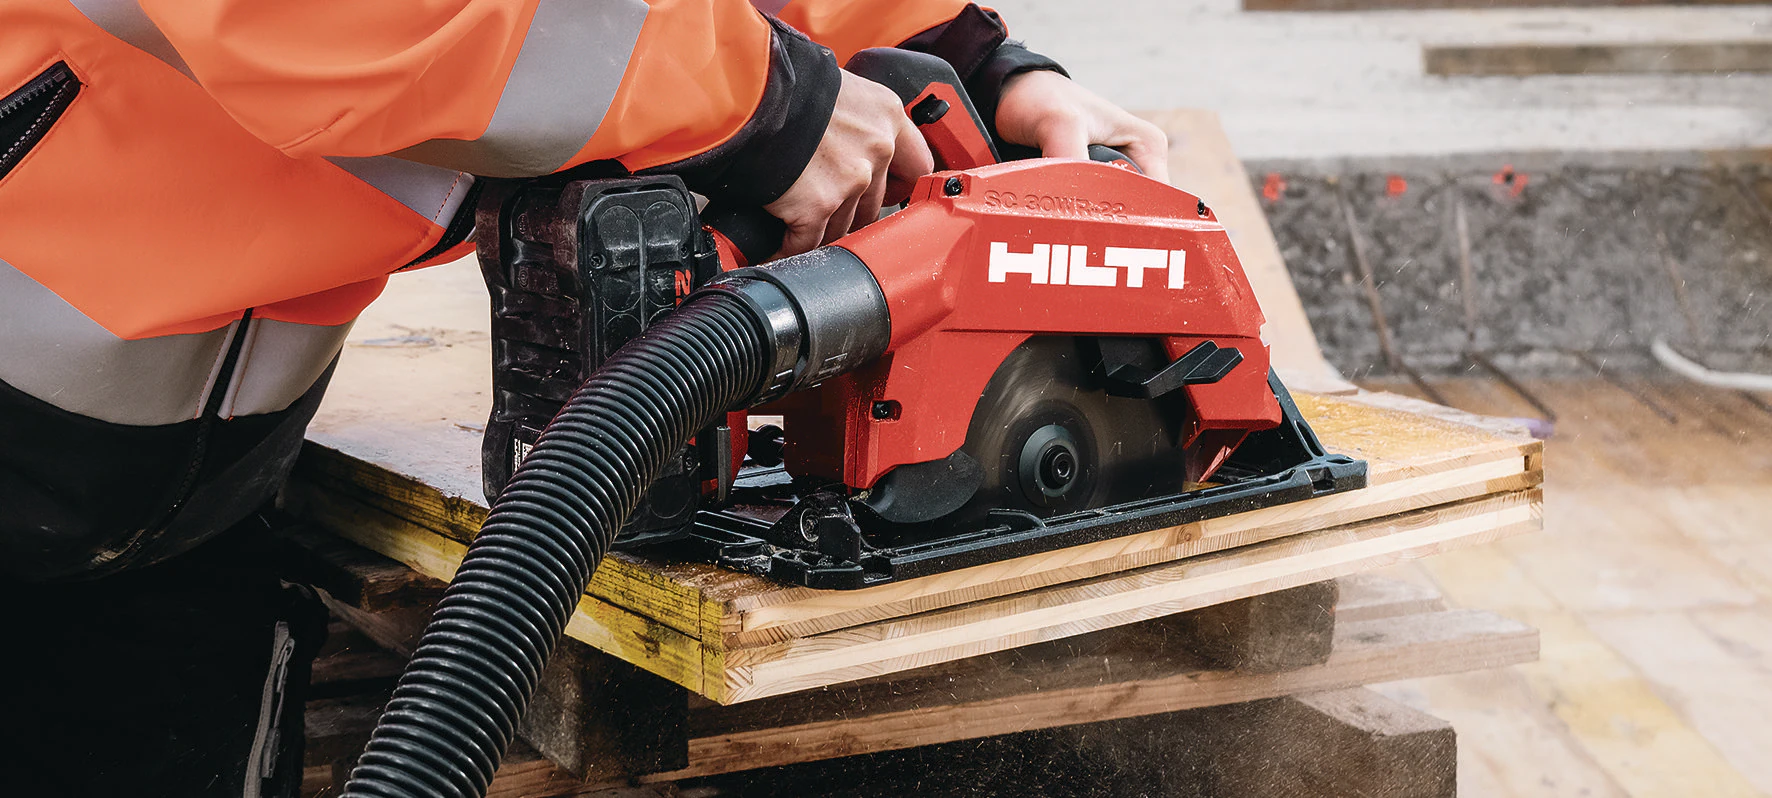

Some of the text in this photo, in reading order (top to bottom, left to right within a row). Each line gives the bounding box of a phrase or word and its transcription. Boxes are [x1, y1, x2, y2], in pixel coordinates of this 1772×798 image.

[984, 190, 1129, 220] SC 30WR-22
[988, 241, 1187, 290] HILTI
